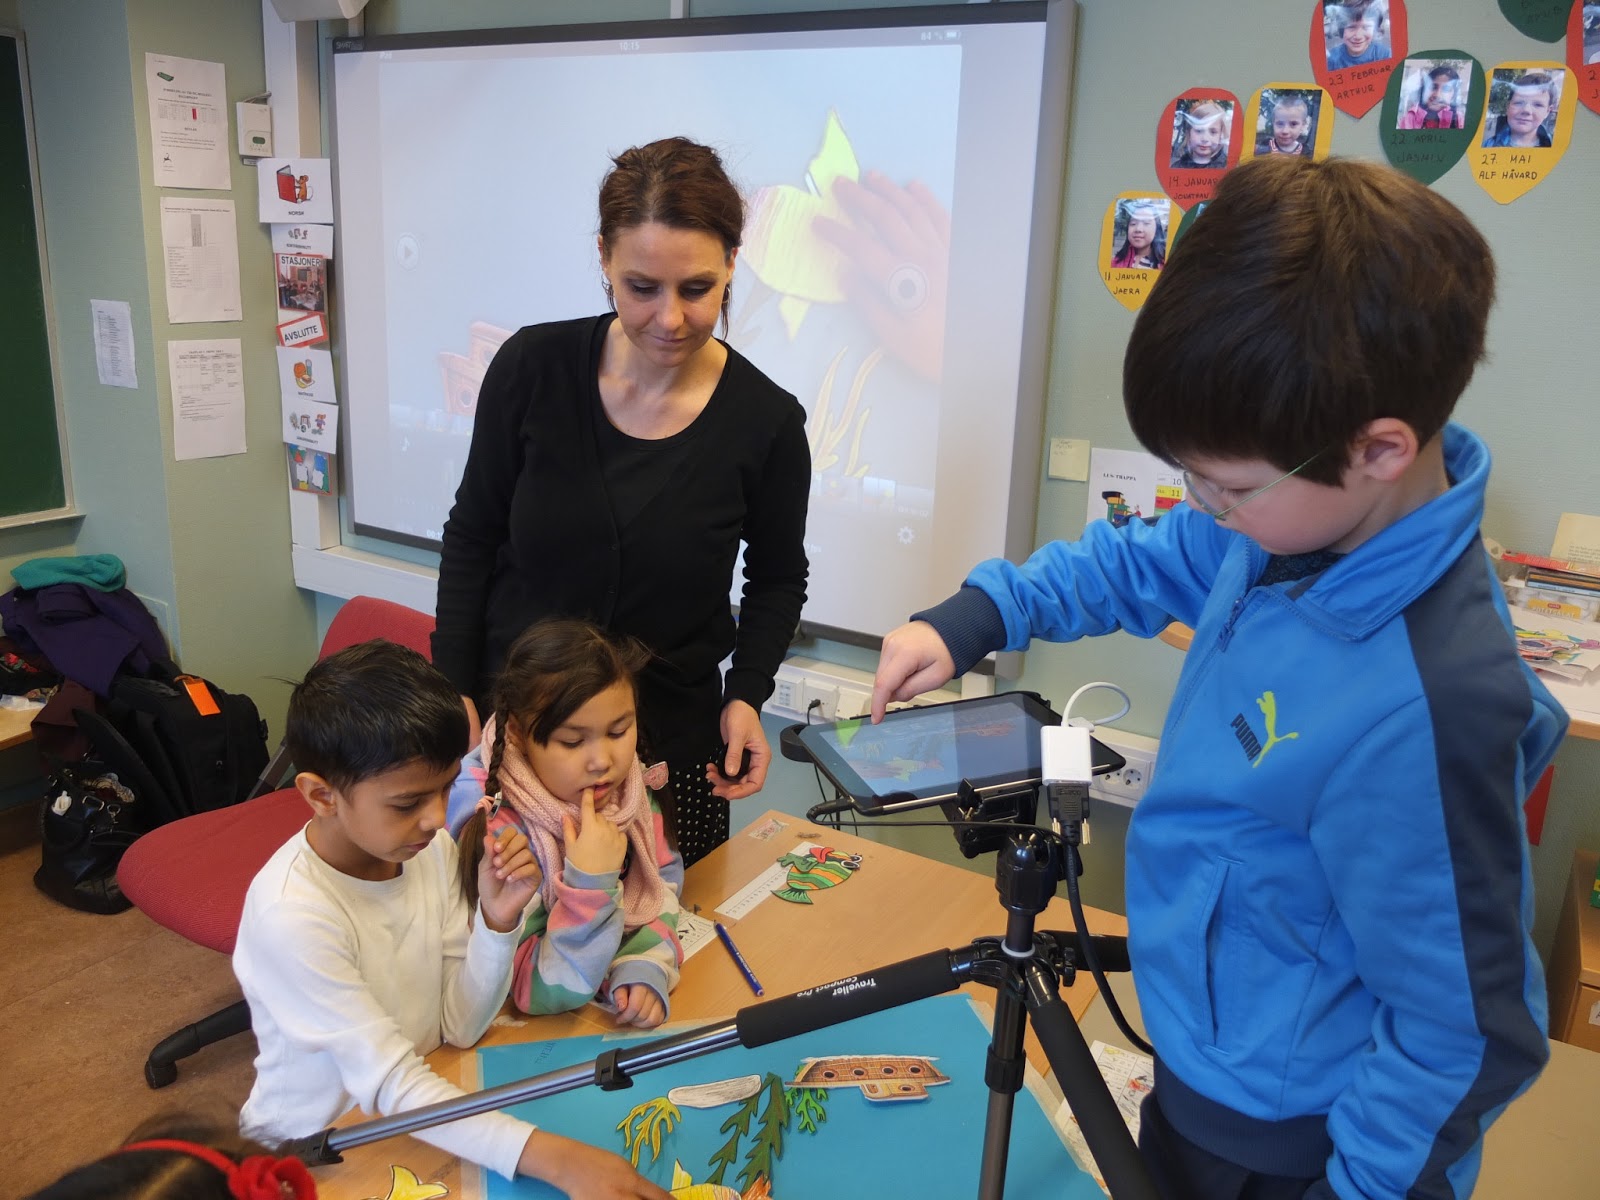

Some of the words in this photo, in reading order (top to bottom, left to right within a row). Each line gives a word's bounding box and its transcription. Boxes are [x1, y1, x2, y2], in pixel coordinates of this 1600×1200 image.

[619, 41, 640, 50] 10:15
[1329, 74, 1344, 86] 23
[1351, 65, 1392, 80] FEBRUAR
[1337, 84, 1375, 100] ARTHUR
[1414, 134, 1447, 143] APRIL
[1510, 154, 1531, 164] MAI
[1478, 170, 1497, 180] ALF
[1501, 169, 1538, 180] HÅVARD
[1173, 192, 1209, 200] JONATHAN
[281, 256, 321, 266] STASJONER
[1115, 272, 1148, 281] JANUAR
[1113, 286, 1141, 295] JAERA
[284, 325, 318, 342] AVSLUTTE
[1173, 478, 1182, 486] 10
[1171, 489, 1180, 497] 11
[1230, 712, 1262, 762] PUMA
[815, 976, 857, 992] Compact
[832, 978, 877, 996] Traveller
[797, 989, 812, 997] Pro
